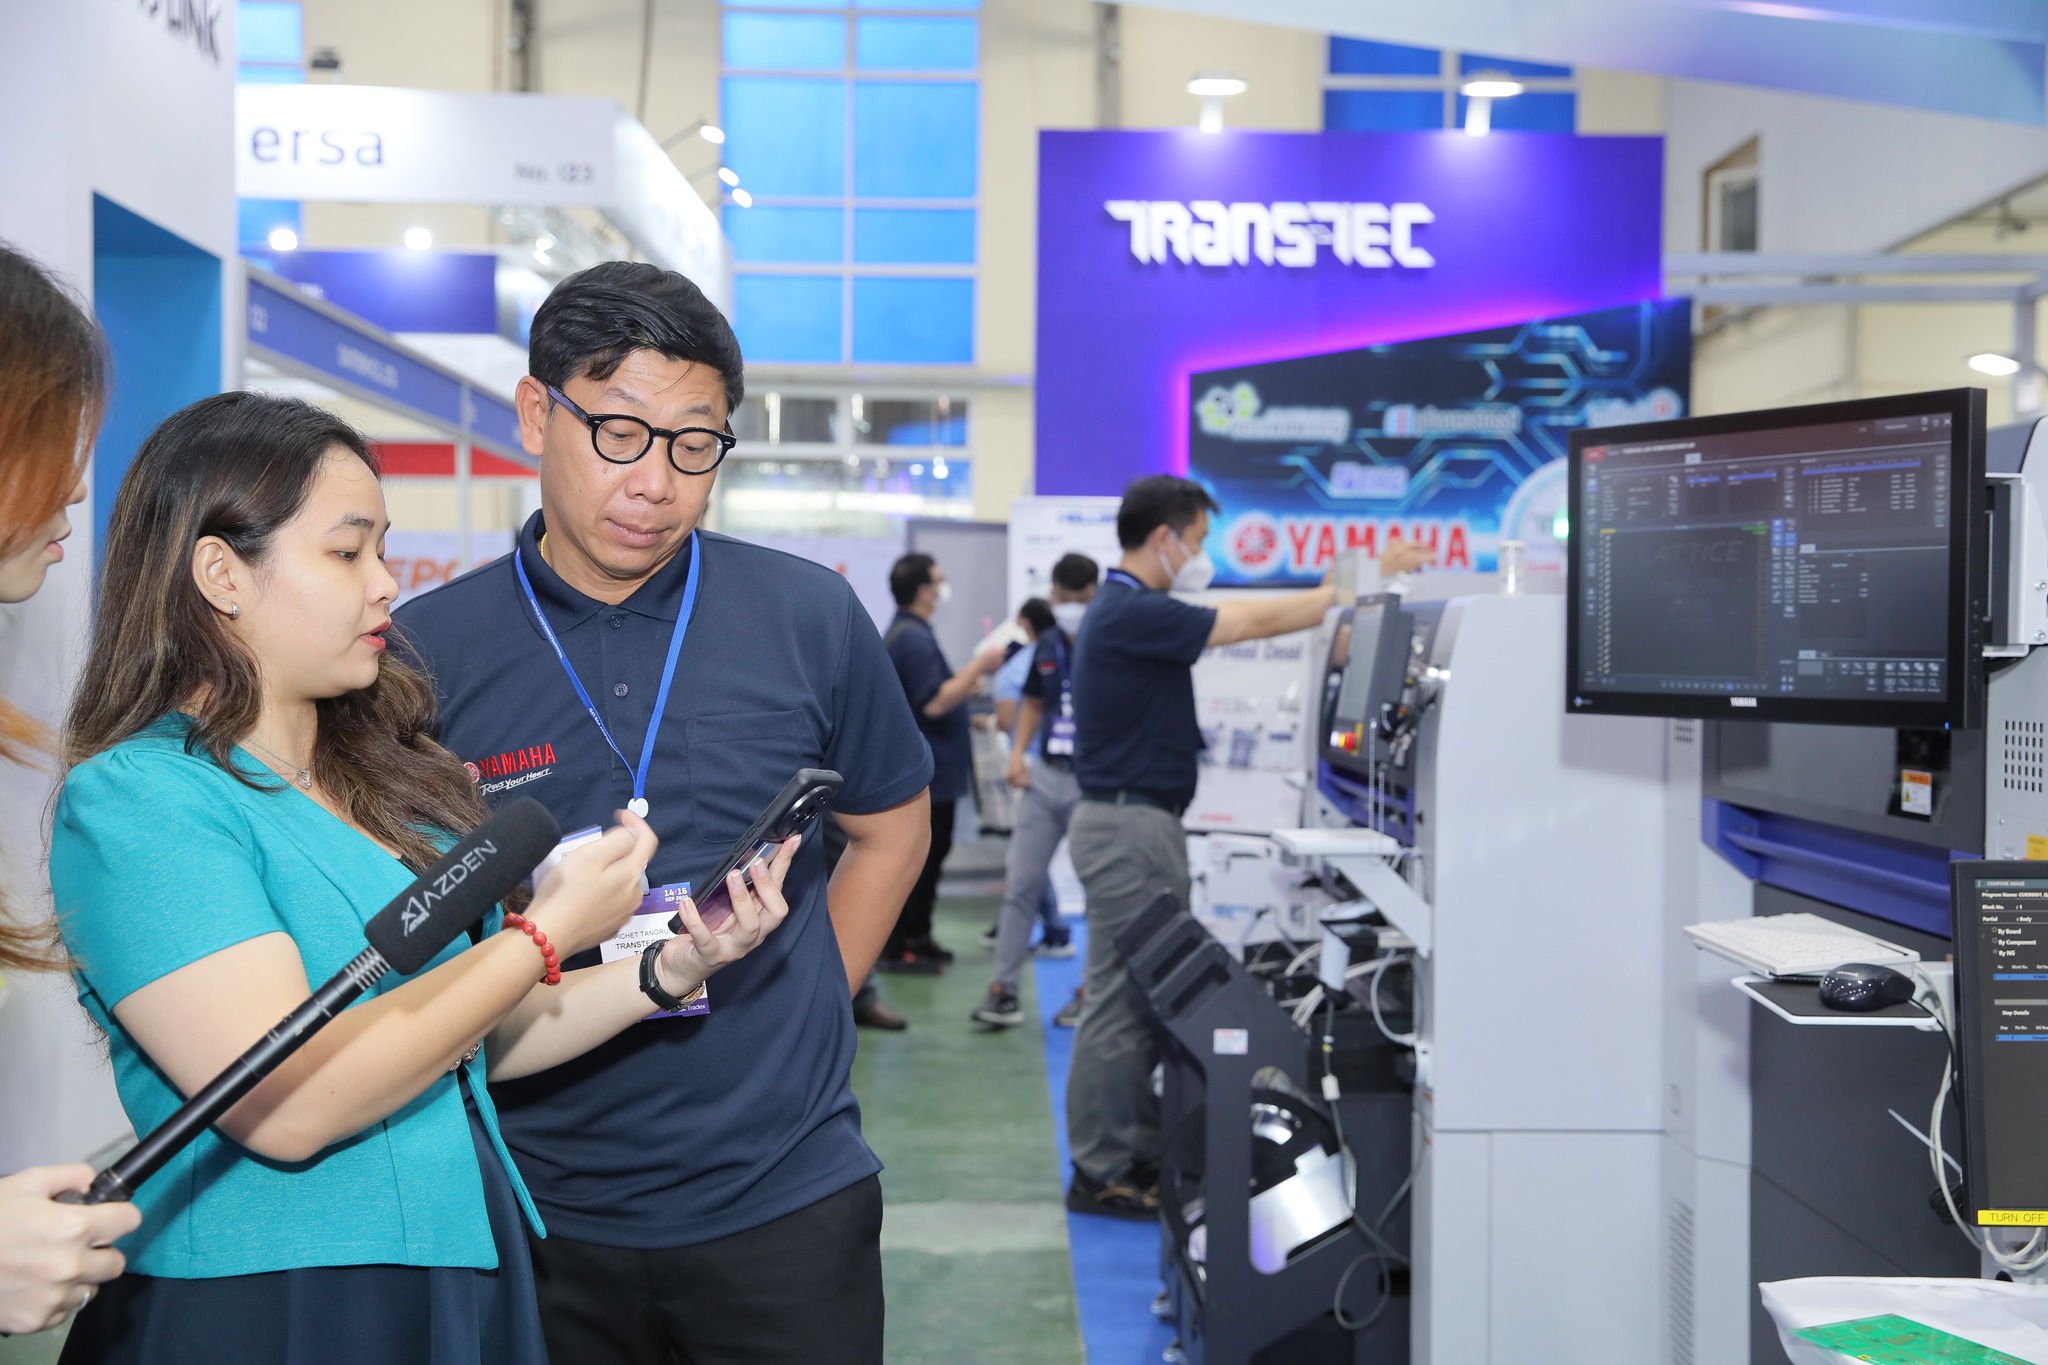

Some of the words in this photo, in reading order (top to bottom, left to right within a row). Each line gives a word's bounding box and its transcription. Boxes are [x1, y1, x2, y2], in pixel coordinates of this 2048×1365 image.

[252, 126, 383, 166] ersa
[478, 743, 556, 779] YAMAHA
[480, 780, 505, 796] Revs
[504, 775, 527, 790] Your
[526, 767, 552, 782] Heart
[423, 839, 498, 909] AZDEN
[640, 928, 671, 937] TANGRU
[1997, 928, 2005, 936] By
[1989, 1212, 2018, 1222] TURN
[2023, 1212, 2045, 1223] OFF
